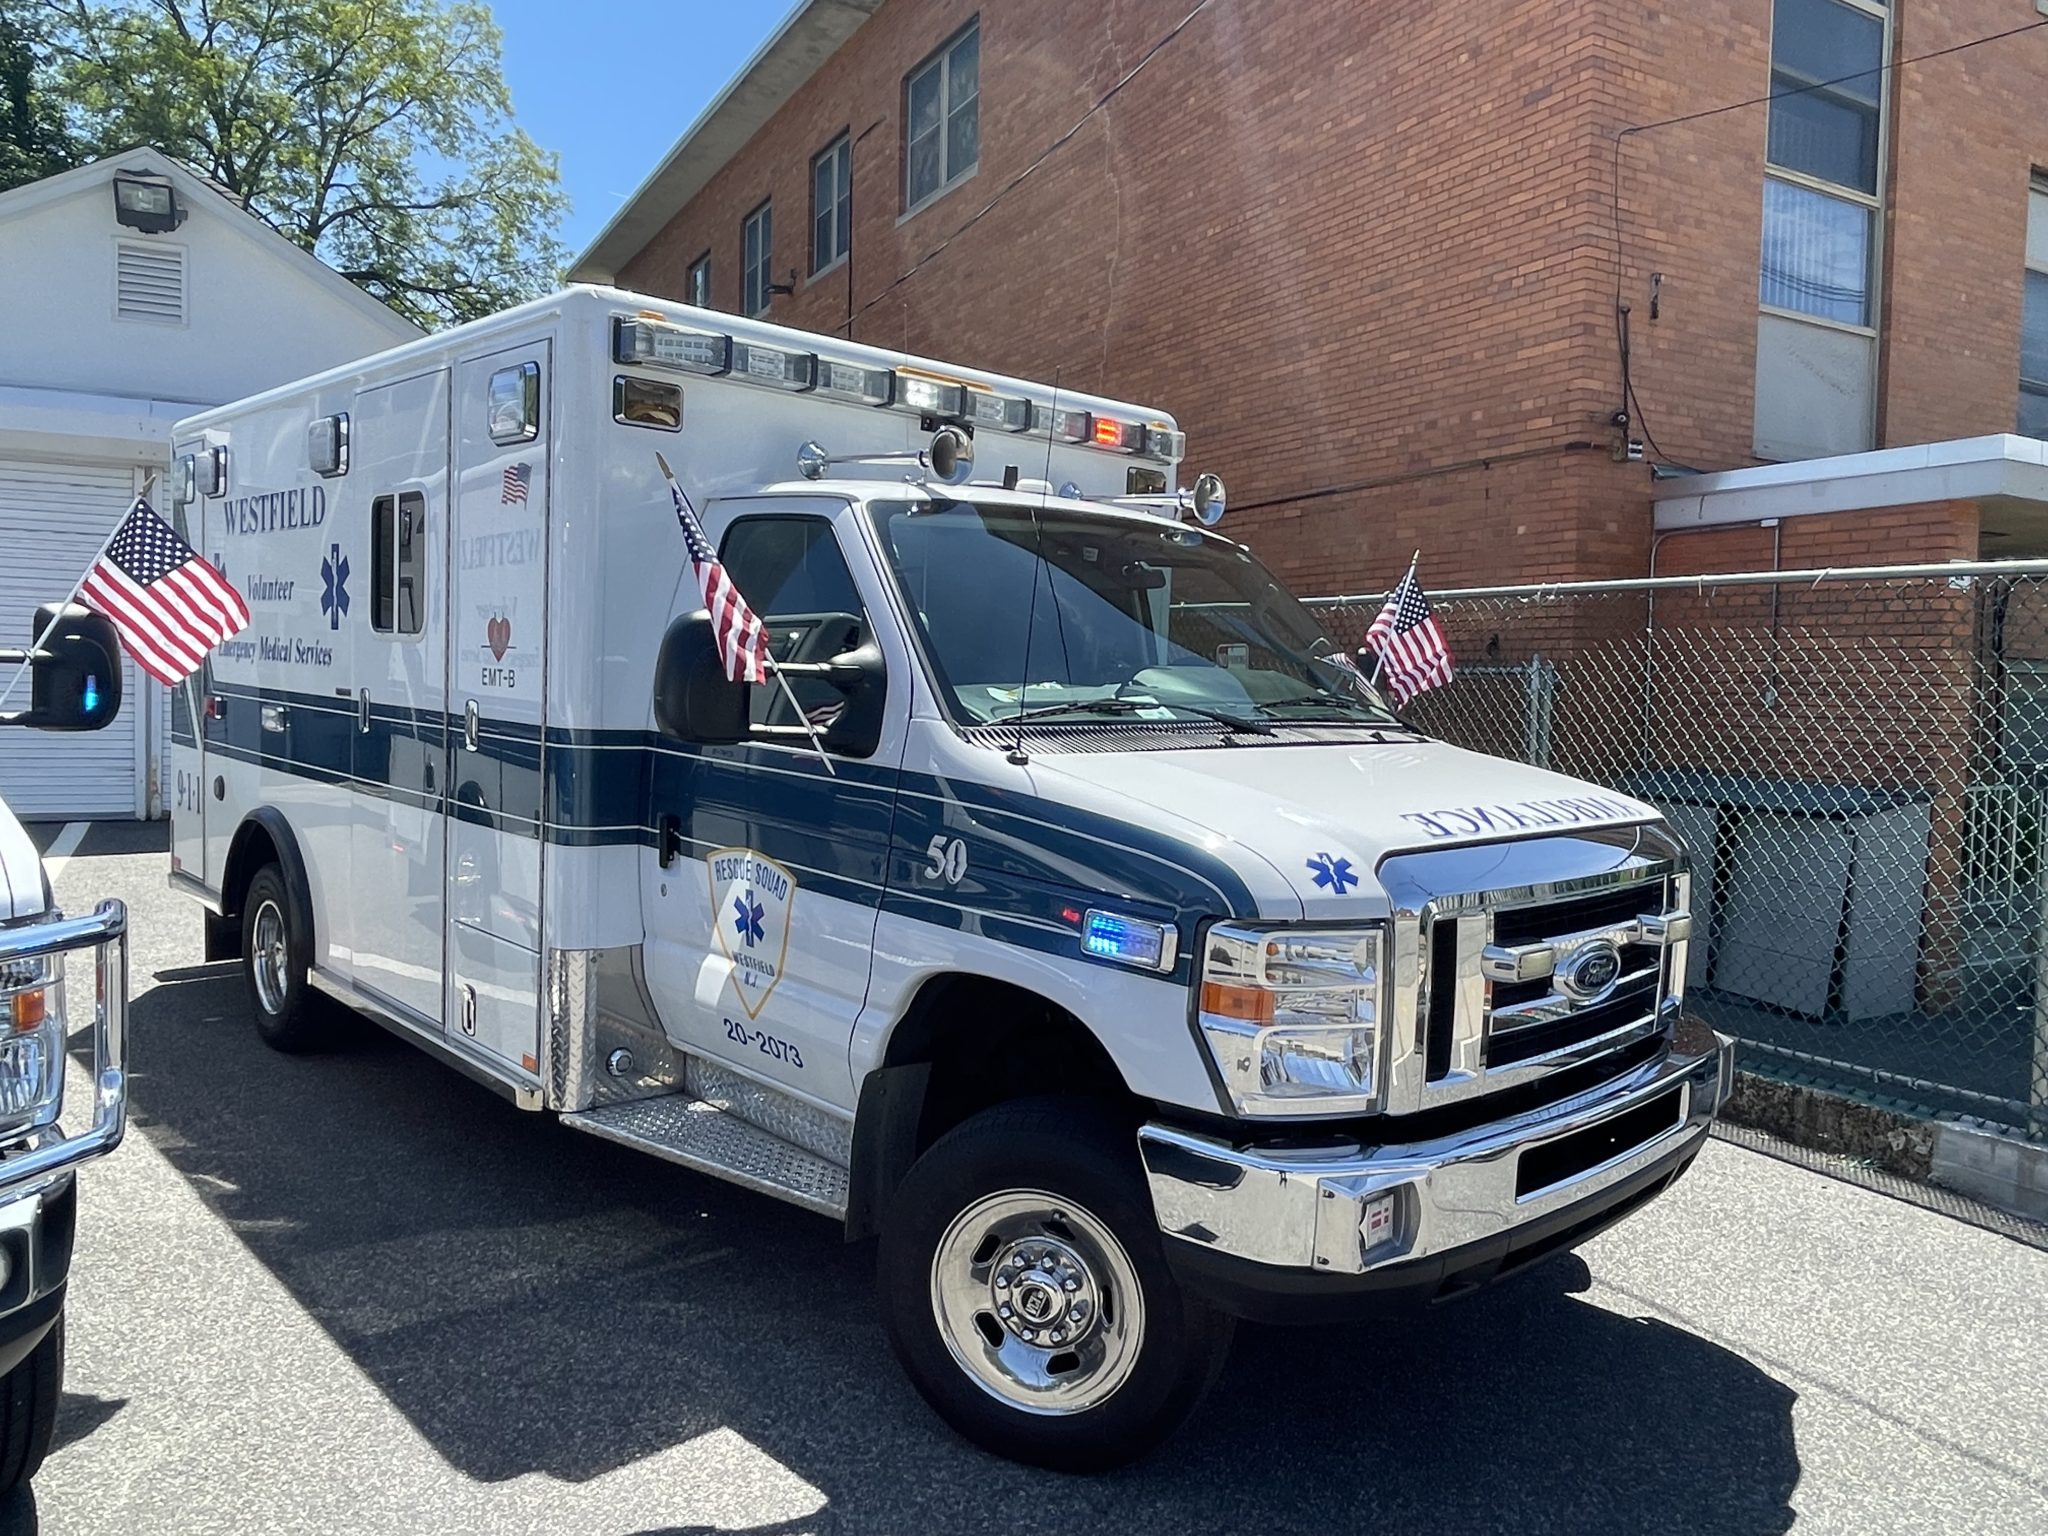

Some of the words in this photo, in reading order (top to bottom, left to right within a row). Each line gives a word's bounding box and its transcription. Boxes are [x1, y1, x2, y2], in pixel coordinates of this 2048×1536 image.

[224, 485, 326, 536] WESTFIELD
[247, 574, 294, 601] Volunteer
[259, 635, 293, 663] Medical
[295, 637, 333, 667] Services
[481, 667, 516, 688] EMT-B
[177, 768, 201, 815] 9-1-1
[714, 858, 752, 882] RESCUE
[755, 863, 788, 901] SQUAD
[924, 834, 968, 885] 50
[731, 950, 775, 977] WESTFIELD
[723, 1017, 804, 1069] 20-2073
